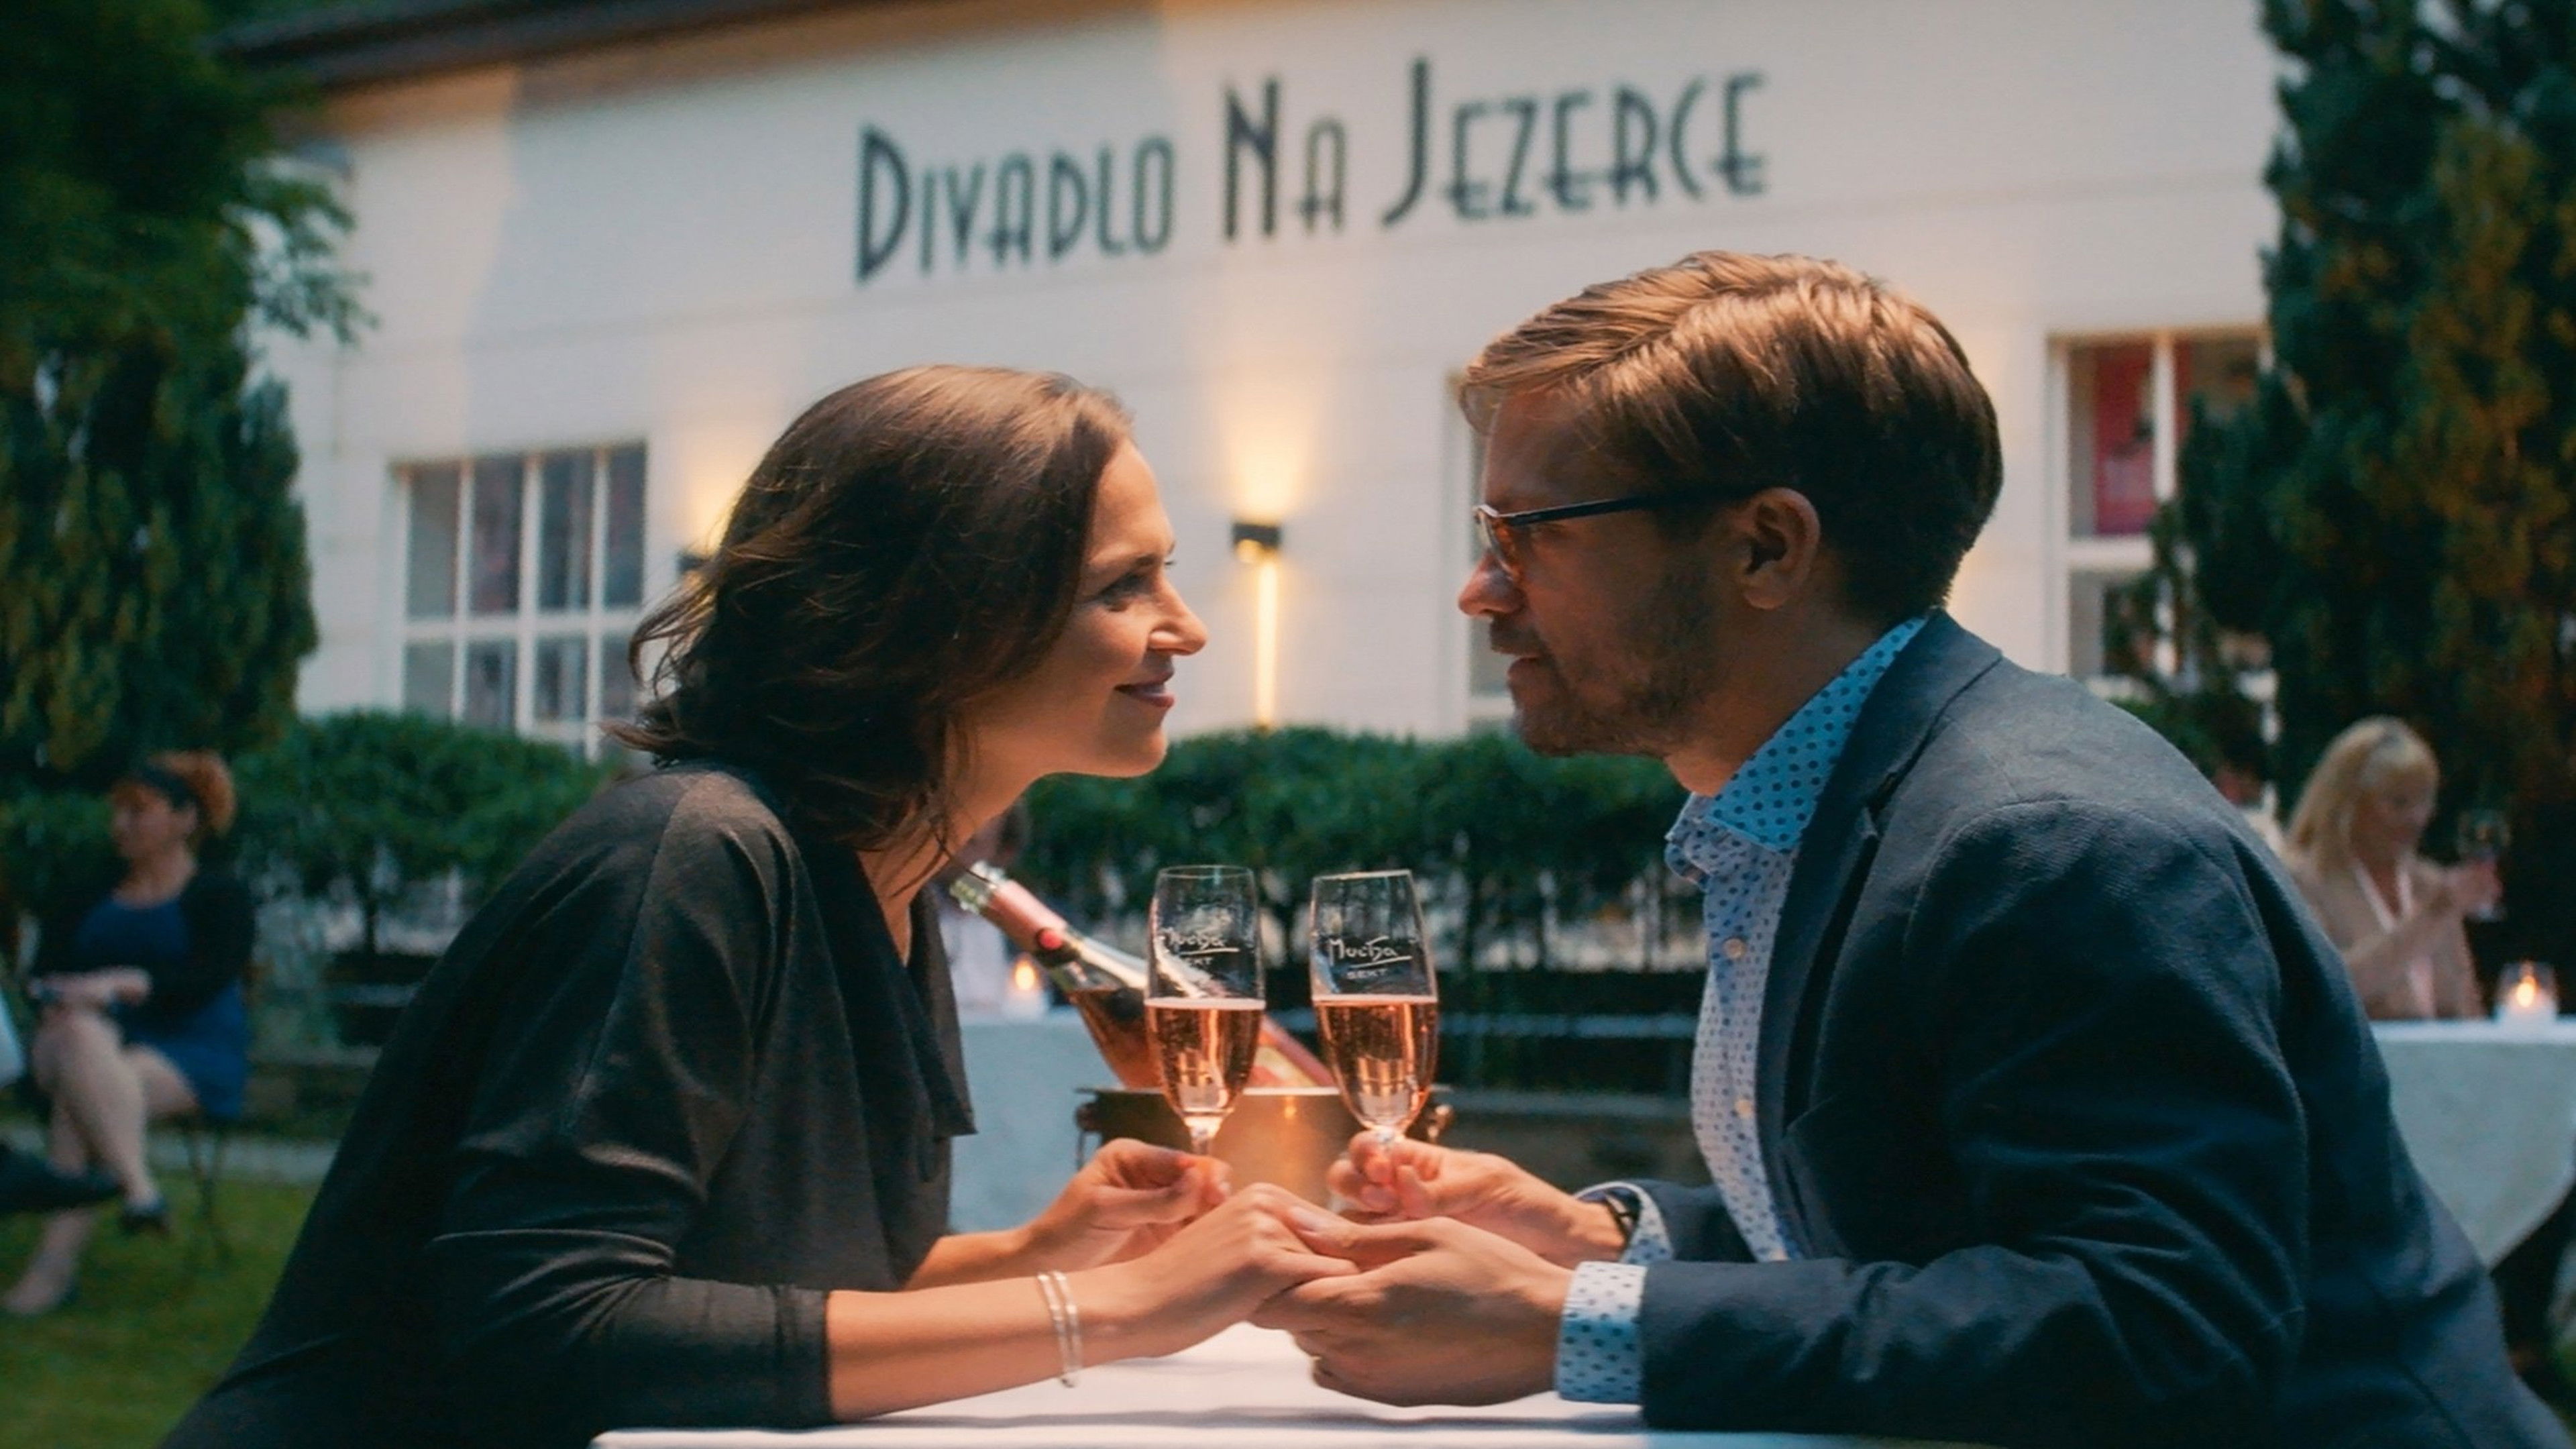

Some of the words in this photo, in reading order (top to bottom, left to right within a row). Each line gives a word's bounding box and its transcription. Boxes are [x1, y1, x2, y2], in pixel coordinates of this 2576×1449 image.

[856, 123, 1177, 284] DIVADLO
[1222, 75, 1348, 241] NA
[1382, 56, 1767, 227] JEZERCE
[1328, 935, 1399, 966] Mucha
